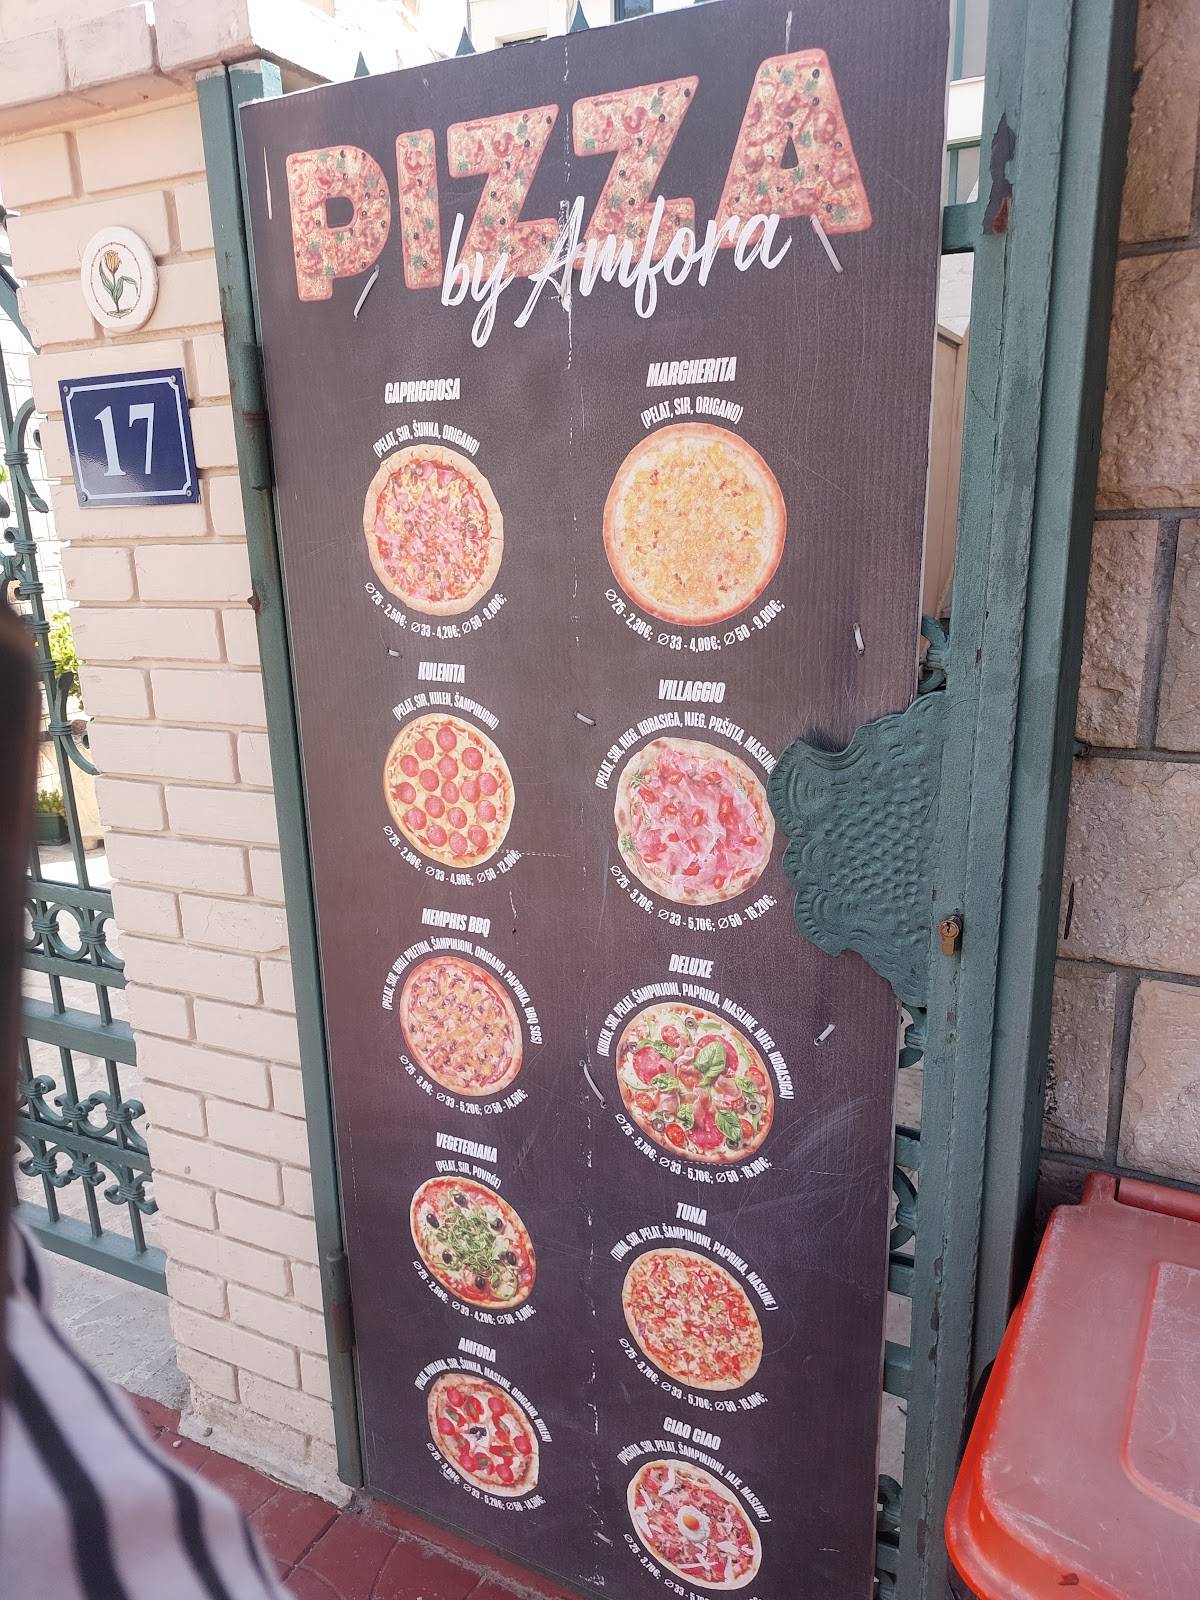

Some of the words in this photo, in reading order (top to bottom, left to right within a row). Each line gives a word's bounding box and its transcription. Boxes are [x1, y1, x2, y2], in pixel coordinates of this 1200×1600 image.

[286, 47, 873, 302] PIZZA
[441, 212, 518, 349] by
[513, 195, 793, 329] Amfora
[646, 356, 737, 387] MARGHERITA
[384, 378, 460, 404] CAPRICCIOSA
[640, 401, 674, 429] (PELAT,
[674, 396, 694, 415] SIR,
[695, 396, 744, 425] ORIGANO)
[94, 403, 155, 476] 17
[373, 431, 398, 458] (PELAT,
[396, 425, 413, 442] SIR,
[412, 420, 441, 439] ŠUNKA,
[443, 424, 480, 457] ORIGANO)
[625, 612, 654, 641] 2,30€;
[689, 635, 721, 652] 4,00€;
[752, 599, 785, 630] 9,00€;
[418, 662, 465, 683] KULENITA
[658, 679, 726, 704] VILLAGGIO
[392, 698, 417, 721] (PELAT,
[414, 693, 430, 707] SIR,
[429, 691, 453, 707] KULEN,
[454, 692, 500, 731] ŠAMPINJONI)
[595, 759, 616, 790] (PELAT,
[607, 744, 626, 763] SIR,
[619, 727, 641, 750] NJEG.
[637, 711, 683, 736] KOBASICA,
[684, 711, 708, 729] NJEG.
[709, 717, 745, 745] PRŠUTA,
[421, 908, 468, 931] MEMPHIS
[467, 915, 491, 938] BBQ
[688, 917, 716, 932] 5,70€;
[430, 935, 474, 956] ŠAMPINJONI,
[474, 945, 506, 976] ORIGANO,
[668, 953, 714, 979] DELUXE
[504, 970, 531, 1008] PAPRIKA,
[631, 982, 682, 1004] ŠAMPINJONI,
[682, 983, 721, 1008] PAPRIKA,
[524, 1006, 538, 1024] BBQ
[604, 1012, 622, 1031] SIR,
[613, 995, 638, 1020] PELAT,
[721, 997, 759, 1033] MASLINE,
[530, 1025, 543, 1045] SOS)
[596, 1027, 615, 1057] (KULEN,
[753, 1027, 776, 1053] NJEG.
[767, 1050, 795, 1100] KOBASICA)
[436, 1132, 498, 1164] VEGETERIANA
[435, 1160, 458, 1173] (PELAT,
[458, 1161, 472, 1176] SIR,
[472, 1165, 501, 1190] POVRĆE)
[675, 1202, 708, 1227] TUNA
[609, 1240, 633, 1263] (TUNA,
[626, 1231, 644, 1248] SIR,
[639, 1225, 664, 1241] PELAT,
[662, 1223, 712, 1251] ŠAMPINJONI,
[712, 1240, 749, 1276] PAPRIKA,
[457, 1336, 496, 1363] AMFORA
[483, 1366, 512, 1393] MASLINE,
[663, 1416, 692, 1440] CIAO
[691, 1427, 722, 1451] CIAO
[677, 1441, 724, 1476] ŠAMPINJONI,
[724, 1470, 743, 1490] JAJE,
